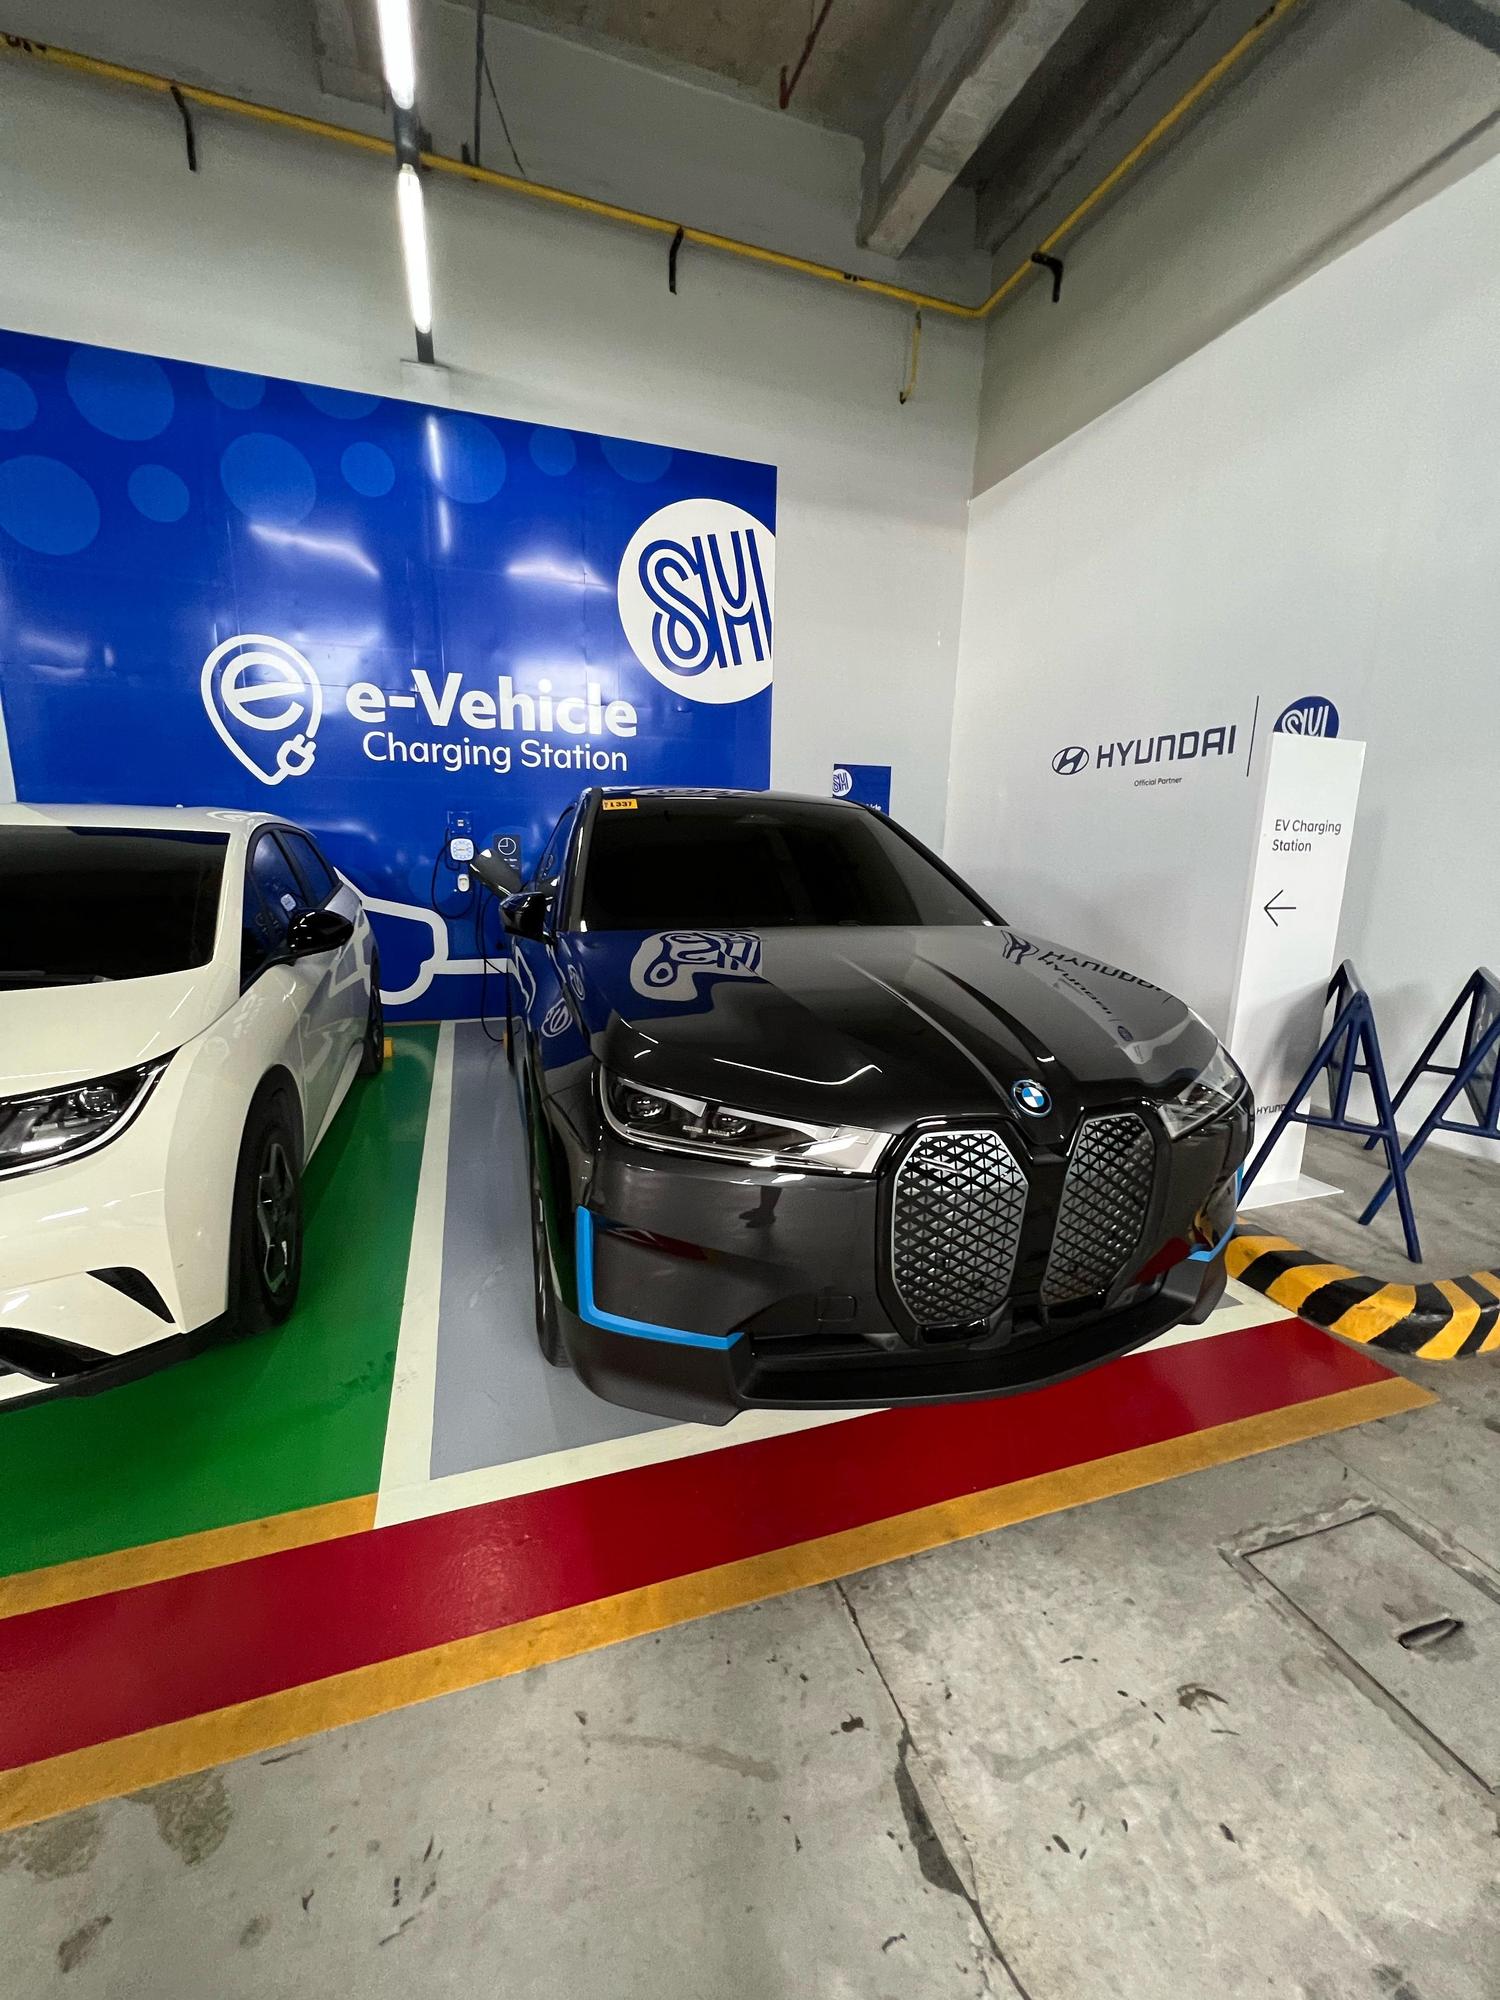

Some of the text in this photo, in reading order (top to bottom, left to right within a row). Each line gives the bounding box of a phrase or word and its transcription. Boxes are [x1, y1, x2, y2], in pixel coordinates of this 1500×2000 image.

[638, 528, 772, 677] SM
[345, 669, 638, 737] e-Vehicle
[362, 731, 628, 774] Charging Station
[1096, 725, 1236, 769] HYUNDAI
[1134, 777, 1183, 787] Official Partner
[1271, 838, 1312, 852] Station
[1275, 819, 1342, 836] EV Charging
